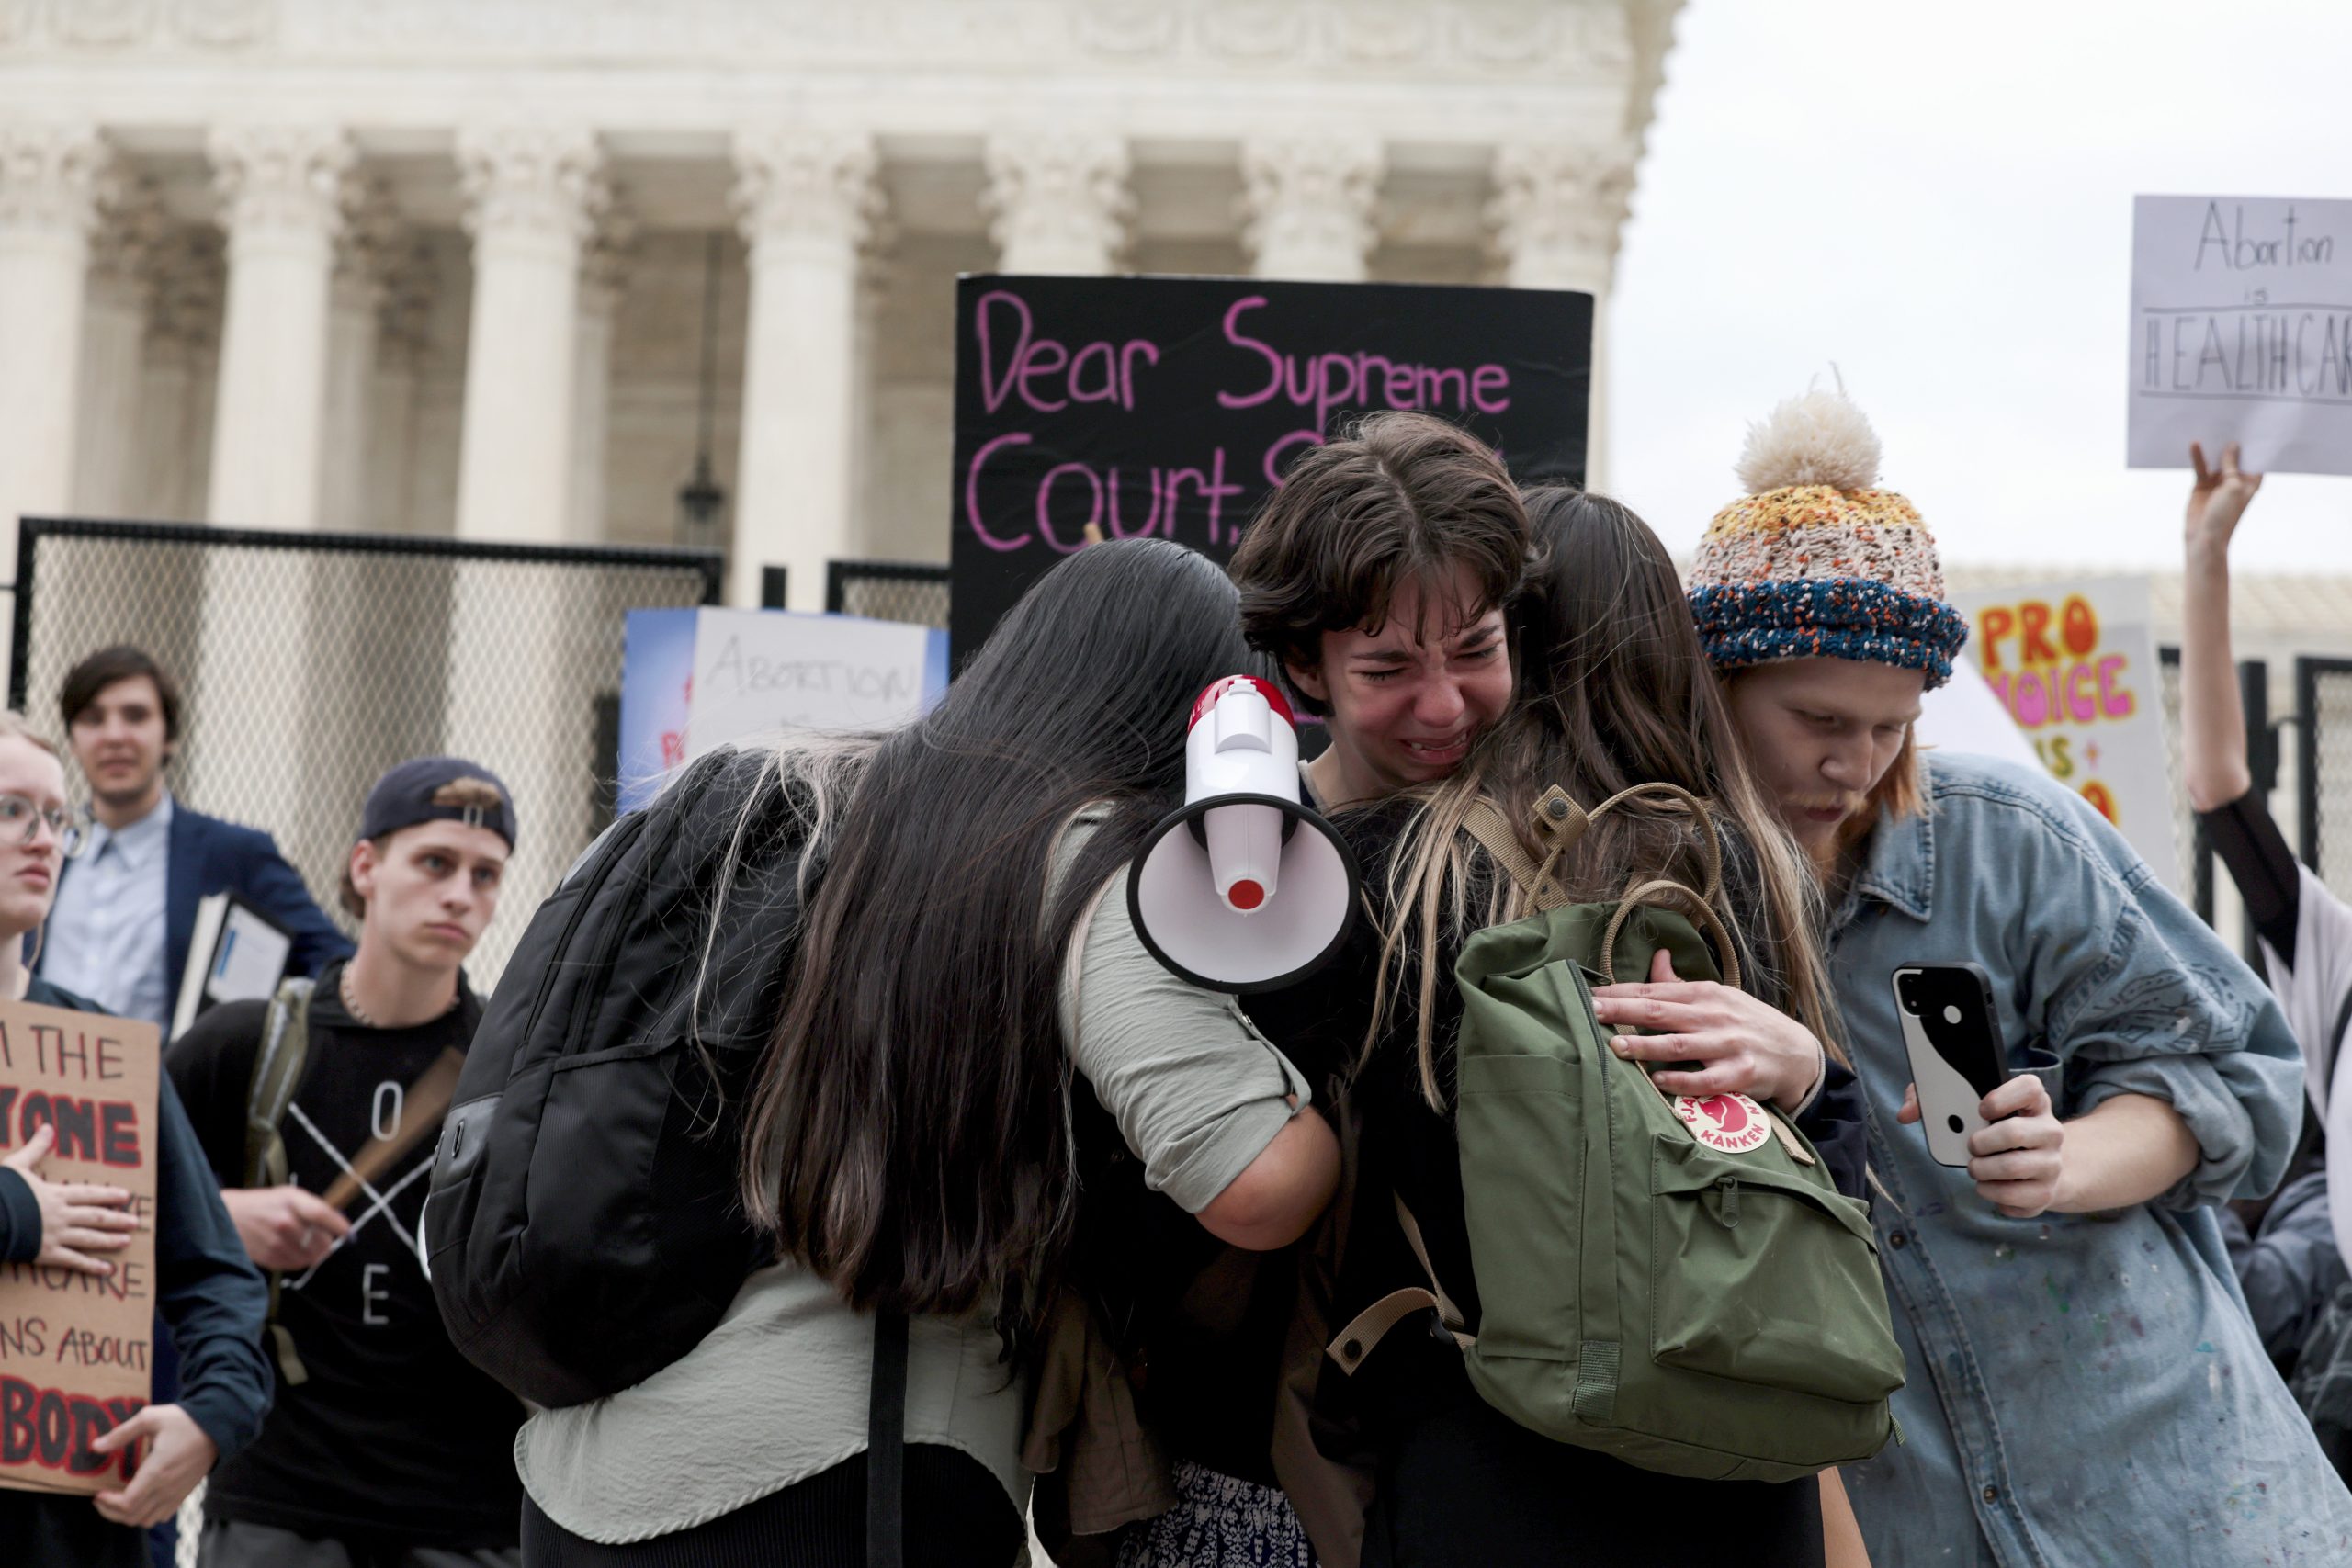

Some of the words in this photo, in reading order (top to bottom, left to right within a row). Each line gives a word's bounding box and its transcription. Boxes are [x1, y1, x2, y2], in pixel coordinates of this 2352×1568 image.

[976, 290, 1159, 414] Dear
[1217, 296, 1510, 434] Supreme
[966, 433, 1242, 552] Court,
[1979, 592, 2098, 670] PRO
[29, 1024, 124, 1080] THE
[56, 1325, 148, 1372] ABOUT
[0, 1374, 152, 1484] BODY
